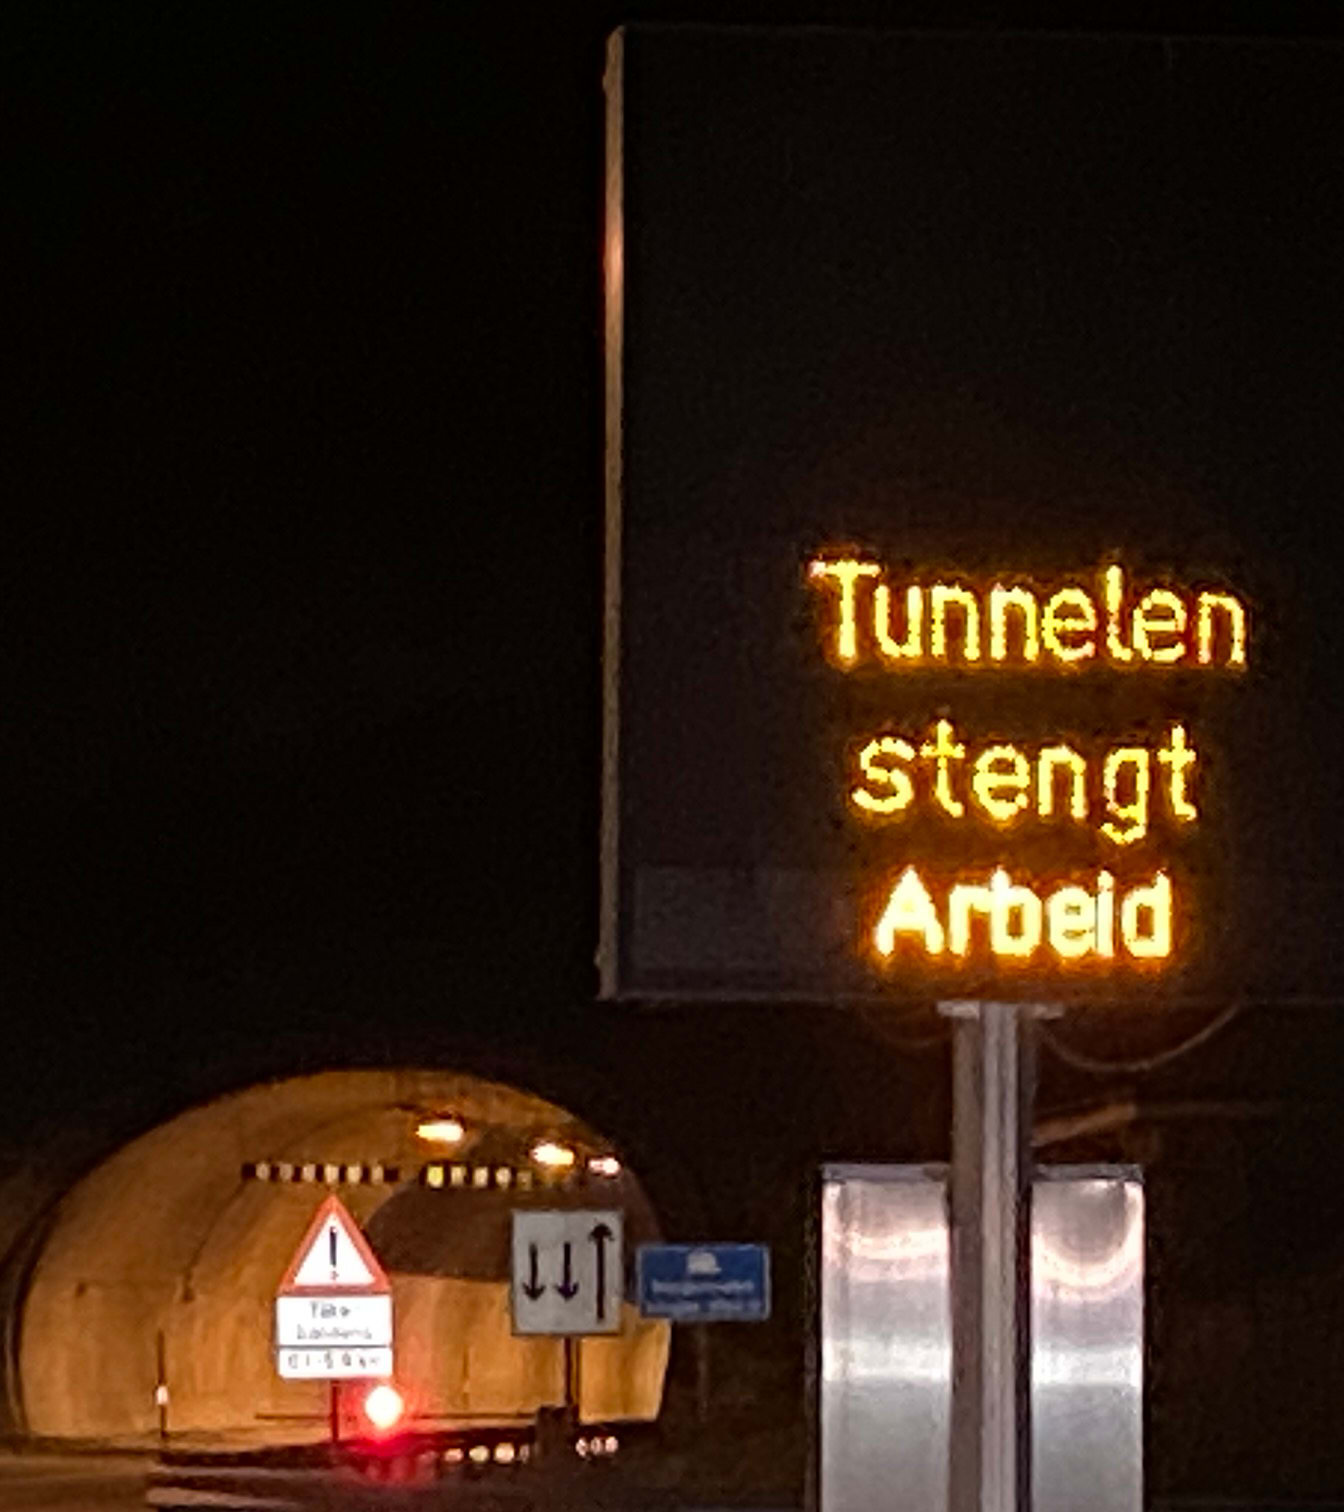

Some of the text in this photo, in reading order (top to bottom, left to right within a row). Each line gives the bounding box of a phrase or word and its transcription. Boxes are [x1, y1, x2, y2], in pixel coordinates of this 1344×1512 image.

[808, 558, 1246, 664] Tunnelen
[851, 719, 1197, 843] stengt
[873, 865, 1173, 958] Arbeid
